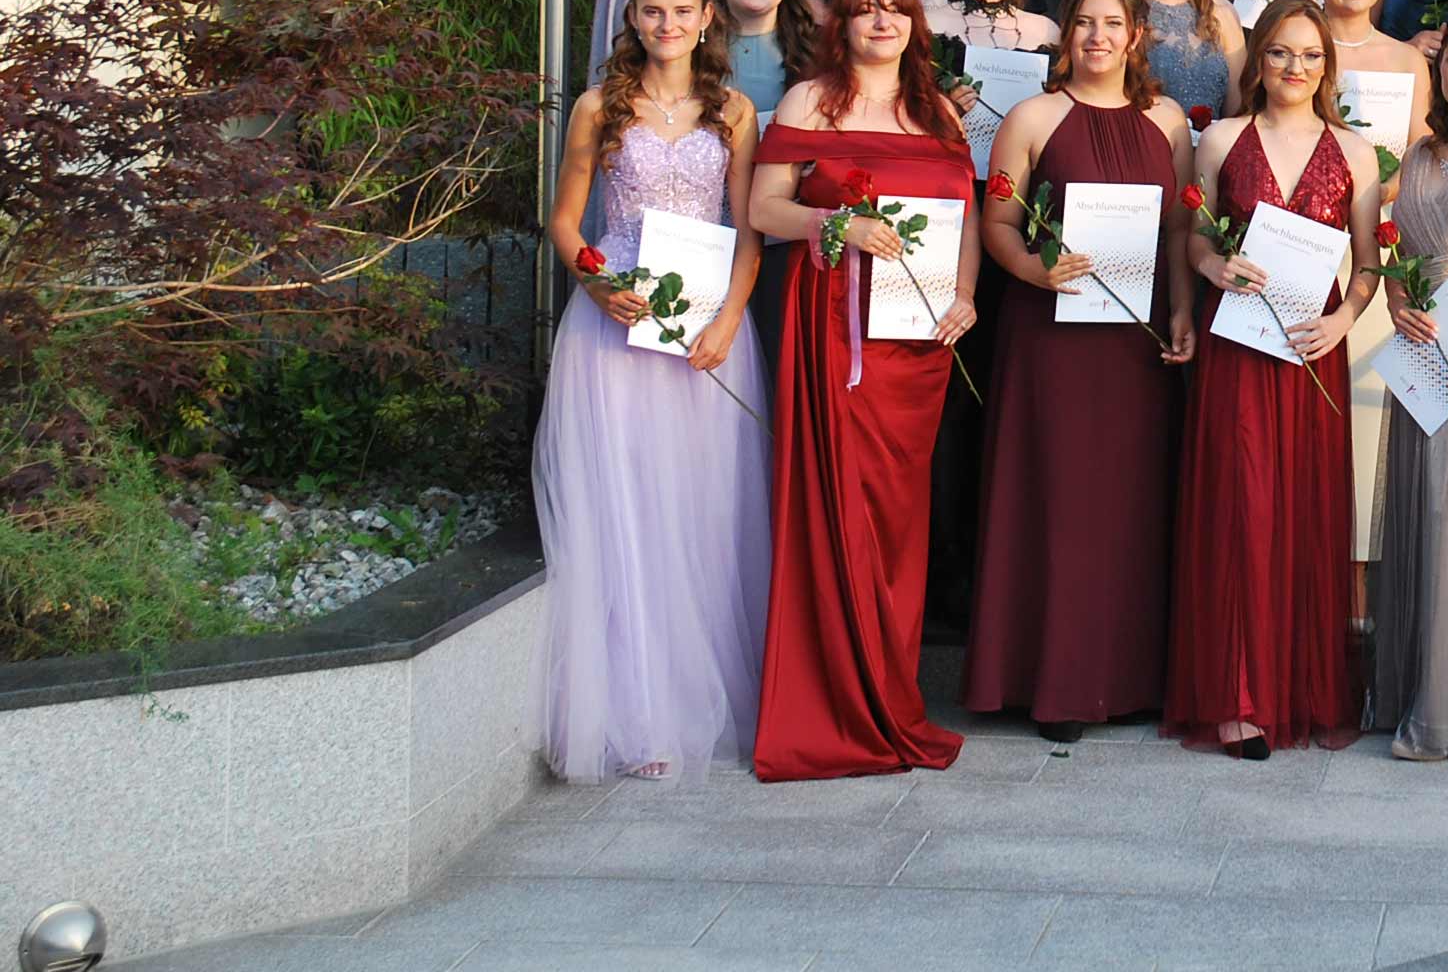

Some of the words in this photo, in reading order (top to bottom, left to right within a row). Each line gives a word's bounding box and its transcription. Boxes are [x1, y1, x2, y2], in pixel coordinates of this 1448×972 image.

[973, 63, 1039, 79] Abschlusszeugnis
[1074, 200, 1151, 214] Abschlusszeugnis
[1260, 221, 1334, 255] Abschlusszeugnis
